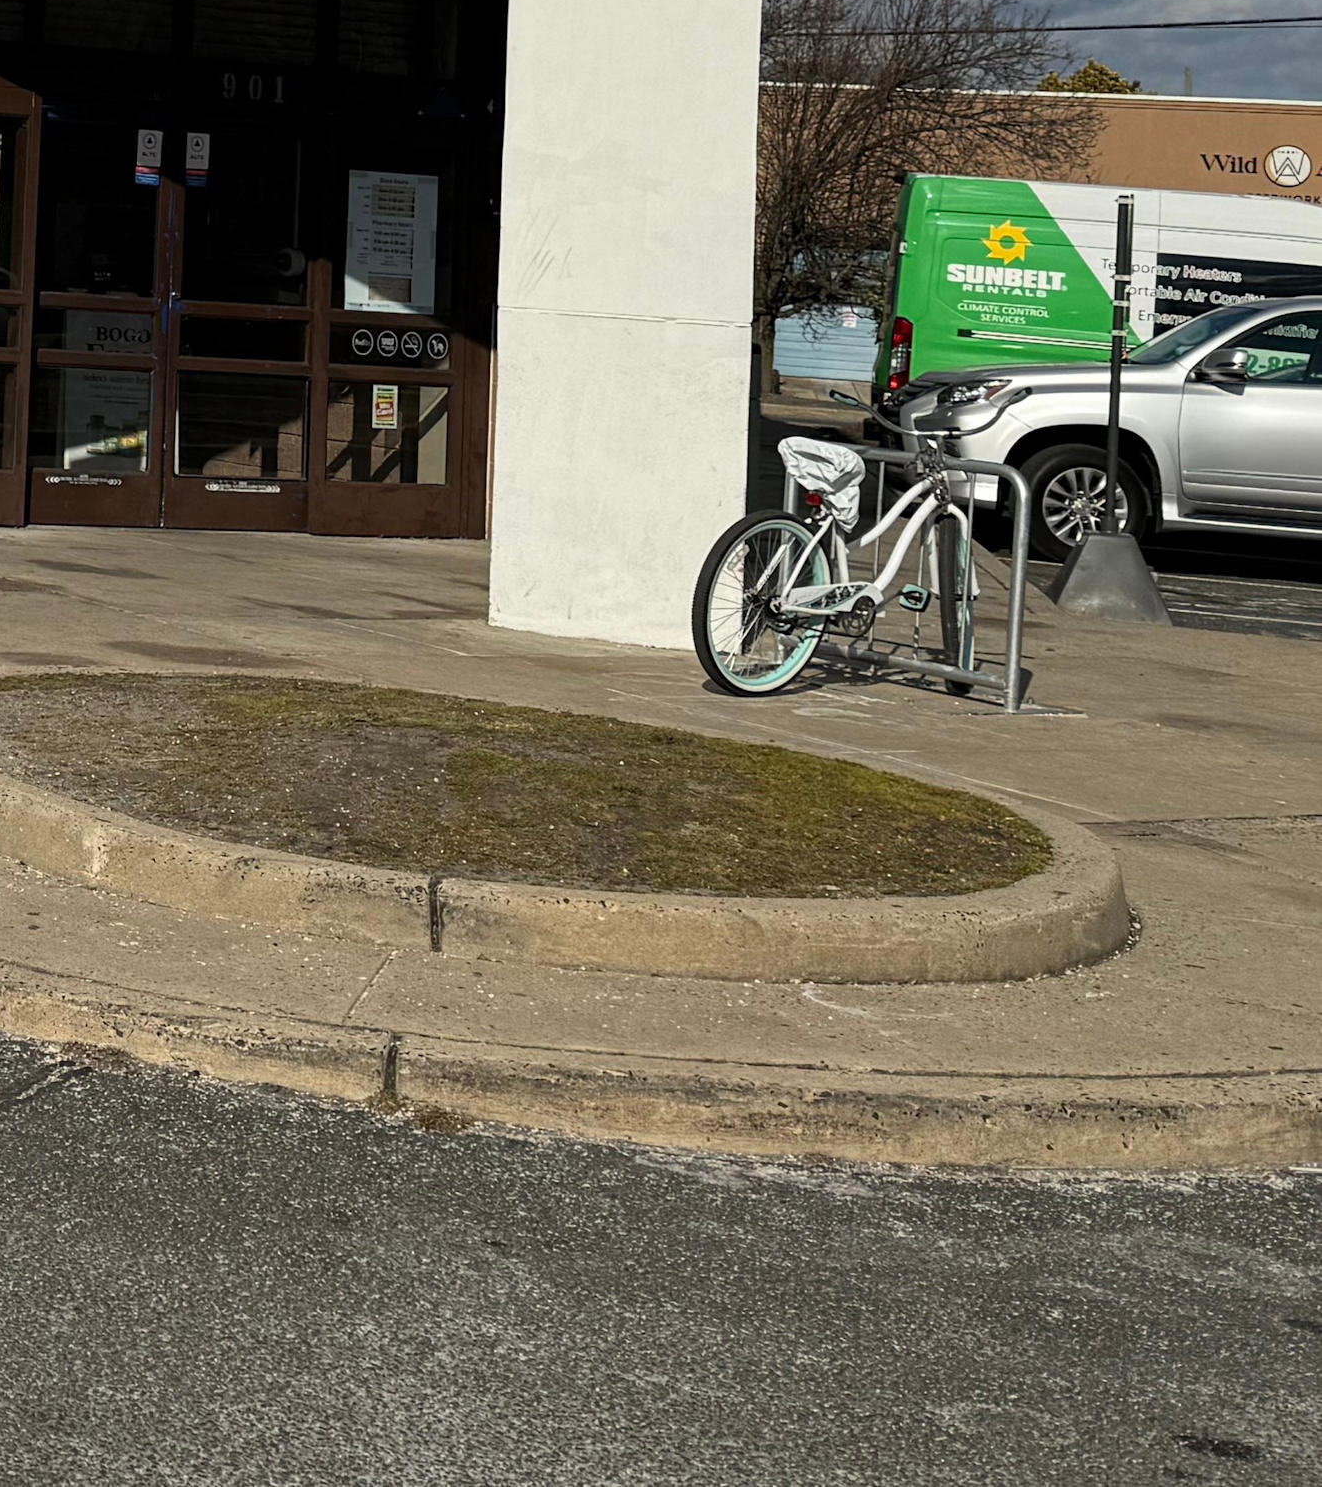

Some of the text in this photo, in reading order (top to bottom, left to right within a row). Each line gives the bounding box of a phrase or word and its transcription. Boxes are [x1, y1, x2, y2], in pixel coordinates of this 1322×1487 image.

[222, 73, 284, 104] 901
[1200, 154, 1258, 174] Wild
[947, 263, 1066, 291] SUNBELT
[1101, 258, 1242, 283] Teporary Heaters
[962, 284, 1047, 298] RENTALS
[1128, 285, 1182, 300] ortable
[1183, 288, 1208, 302] Air
[958, 303, 1050, 318] CLIMATE CONTROL
[981, 314, 1026, 324] SERVICES
[97, 326, 151, 344] BOGO
